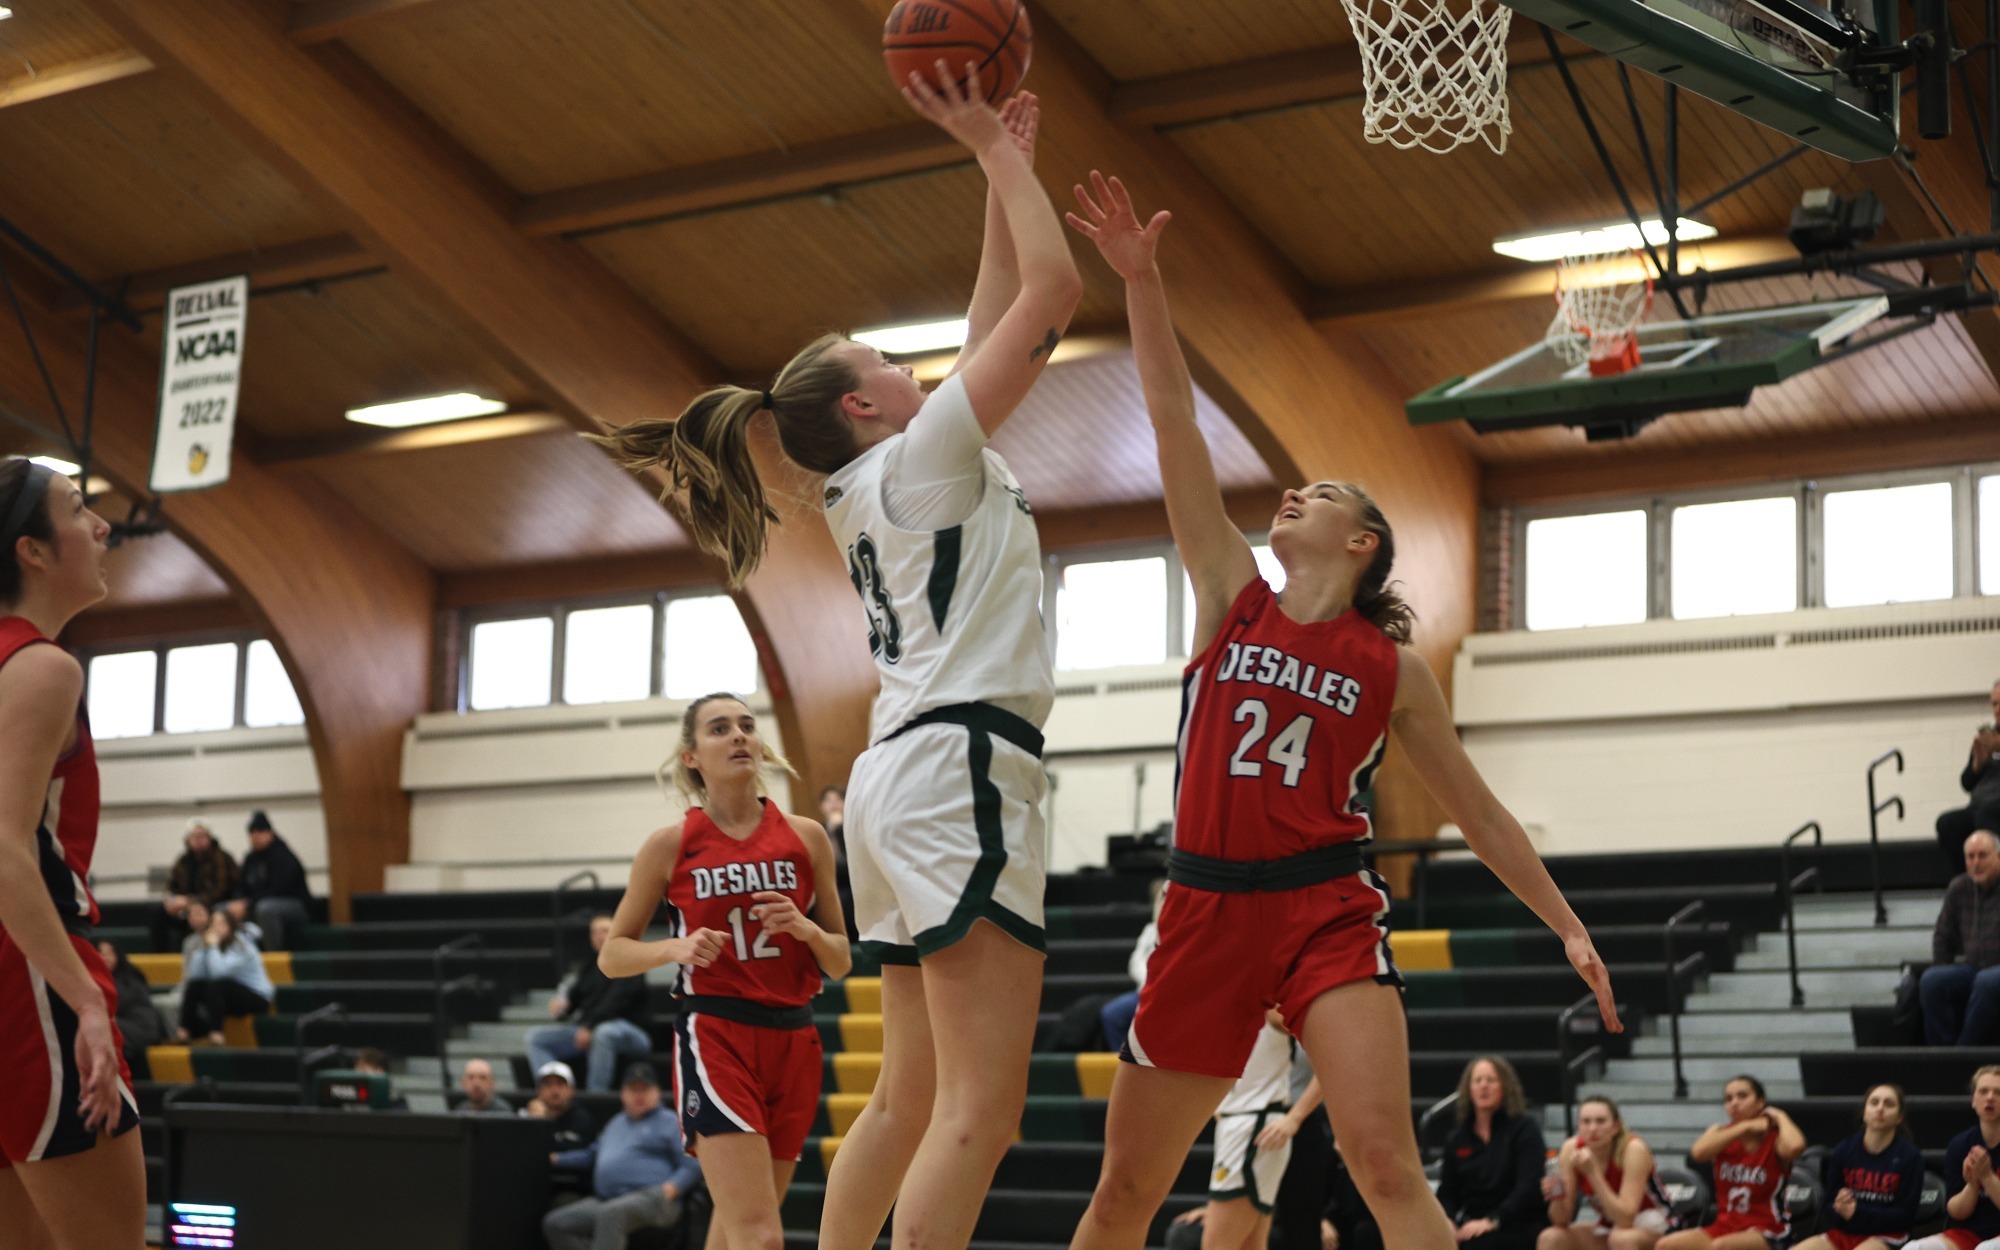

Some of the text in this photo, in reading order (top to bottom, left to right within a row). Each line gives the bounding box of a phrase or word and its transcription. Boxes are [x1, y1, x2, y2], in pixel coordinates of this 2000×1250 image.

[175, 328, 236, 364] NCAA
[180, 398, 226, 427] 2022
[1216, 641, 1361, 717] DESALES
[1229, 698, 1315, 788] 24
[689, 859, 798, 900] DESALES
[726, 903, 782, 962] 12
